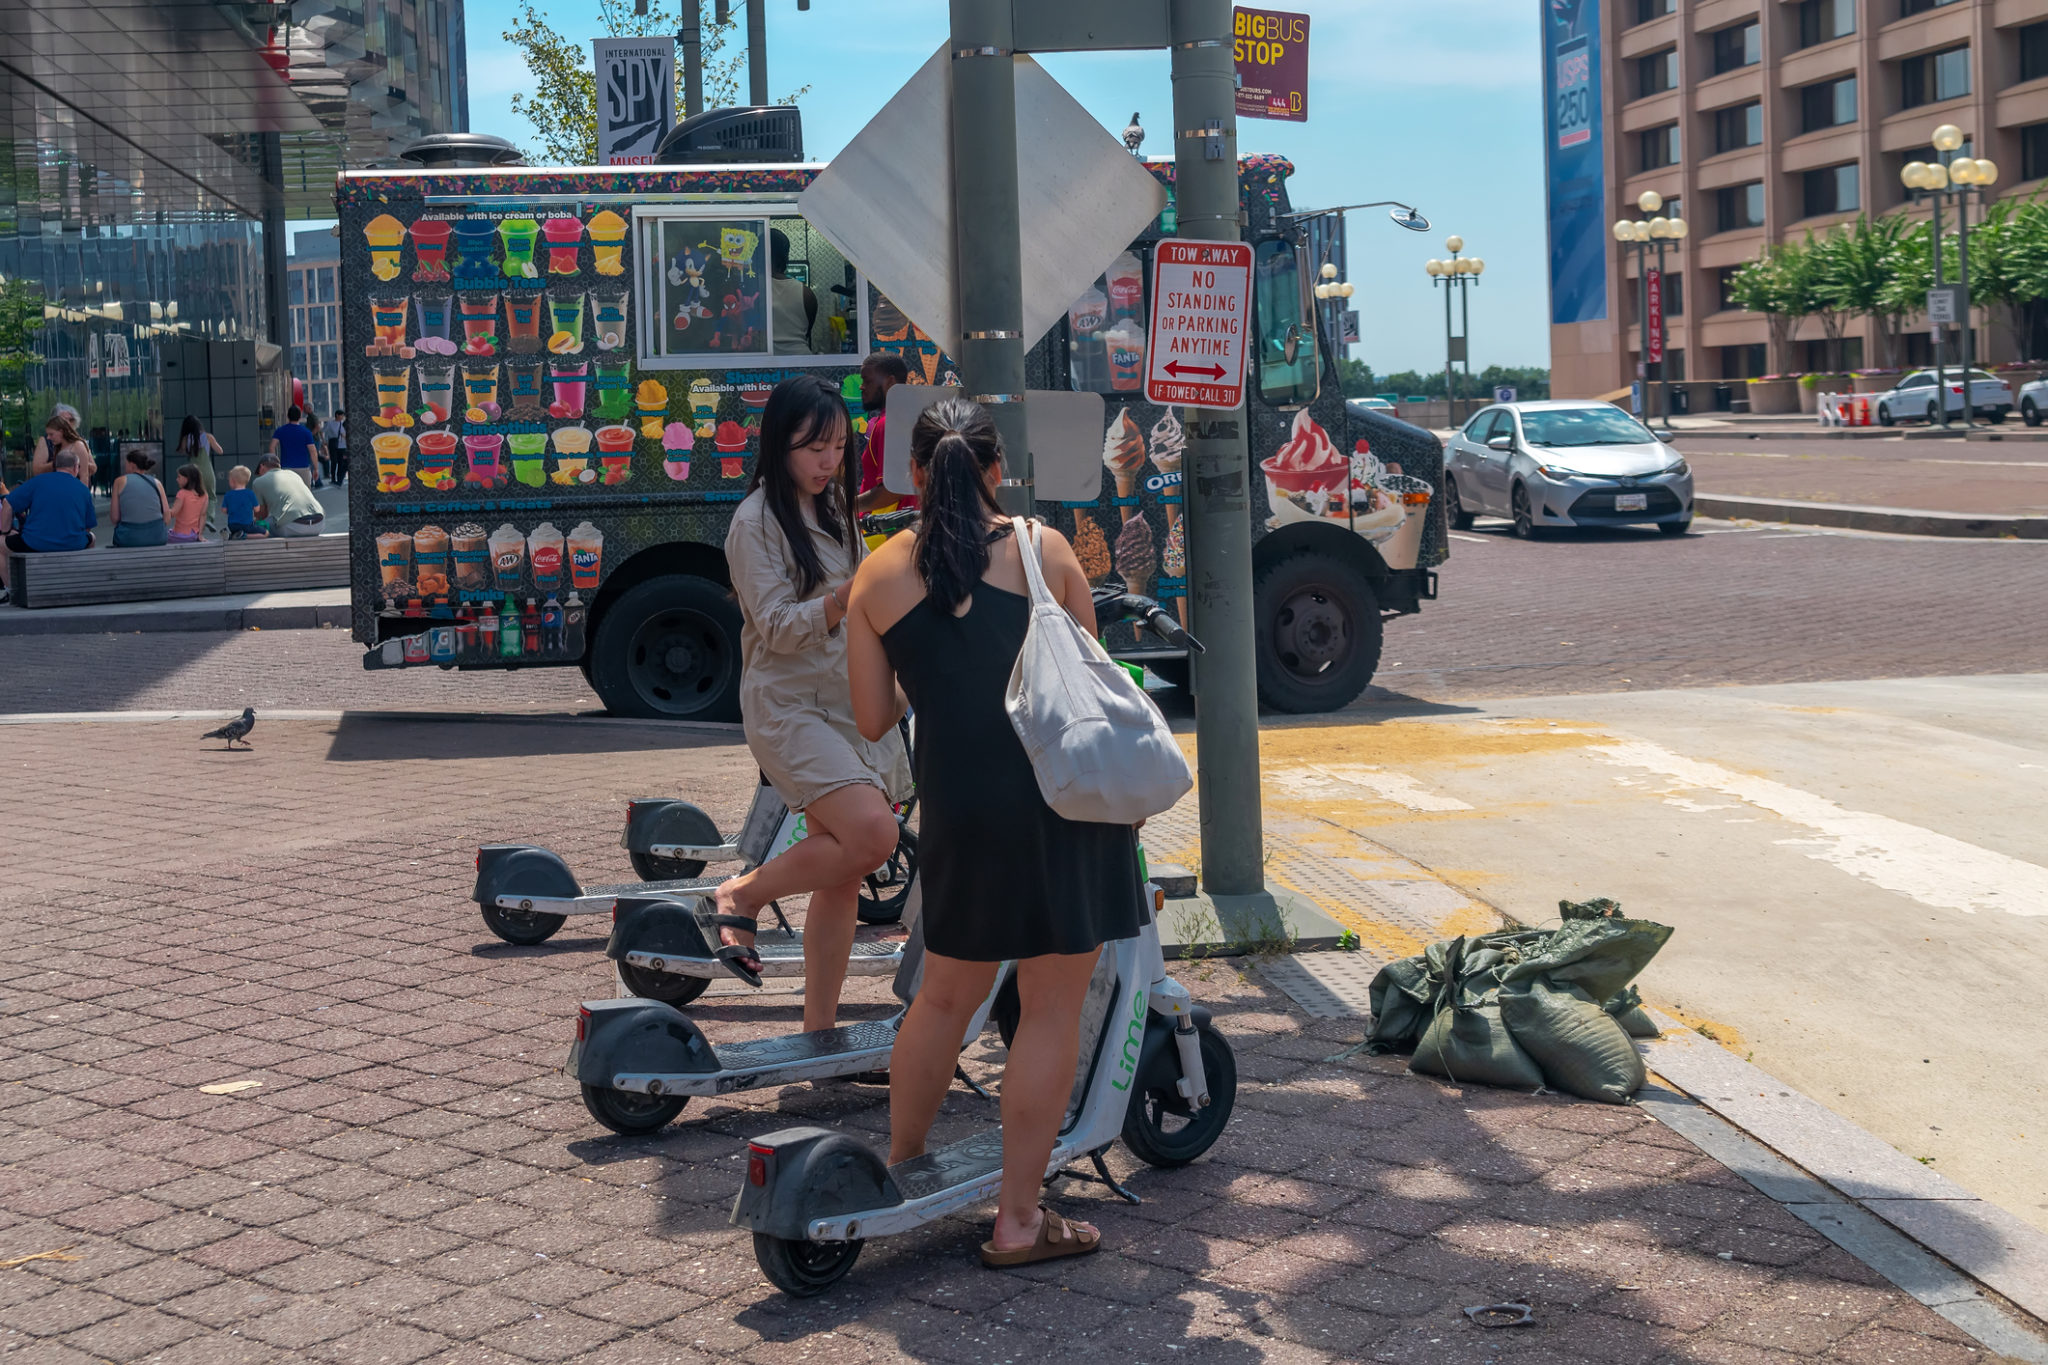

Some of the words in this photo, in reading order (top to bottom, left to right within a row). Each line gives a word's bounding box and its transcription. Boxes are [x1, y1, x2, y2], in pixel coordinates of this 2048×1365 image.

[605, 48, 666, 58] INTERNATIONAL
[1233, 38, 1284, 65] STOP
[606, 59, 668, 122] SPY
[1559, 86, 1588, 130] 250
[421, 212, 464, 221] Available
[466, 212, 487, 220] with
[504, 211, 534, 219] cream
[547, 210, 572, 218] boba
[1171, 247, 1198, 262] TOW
[1202, 249, 1238, 264] AWAY
[454, 276, 507, 290] Bubble
[510, 276, 547, 289] Teas
[1192, 271, 1215, 289] NO
[1168, 293, 1236, 312] STANDING
[1649, 271, 1660, 350] PARKING
[1162, 317, 1175, 331] OR
[1178, 315, 1238, 334] PARKING
[1170, 337, 1230, 356] ANYTIME
[1112, 350, 1140, 364] FANTA
[726, 372, 781, 384] Shaved
[692, 385, 734, 393] Available
[737, 383, 757, 392] with
[1154, 384, 1164, 398] IF
[1166, 385, 1196, 400] TOWED
[1200, 387, 1220, 402] CALL
[1223, 390, 1235, 403] 311
[462, 421, 548, 436] Smoothies
[1147, 472, 1182, 490] ORE
[396, 503, 420, 513] Ice
[425, 501, 481, 513] Coffee
[484, 500, 497, 511] &
[500, 499, 552, 510] Floats
[1112, 496, 1140, 506] Swirl
[1157, 495, 1182, 504] Con
[572, 551, 598, 564] FANTA
[459, 589, 505, 602] Drinks
[1111, 990, 1146, 1091] Lime
